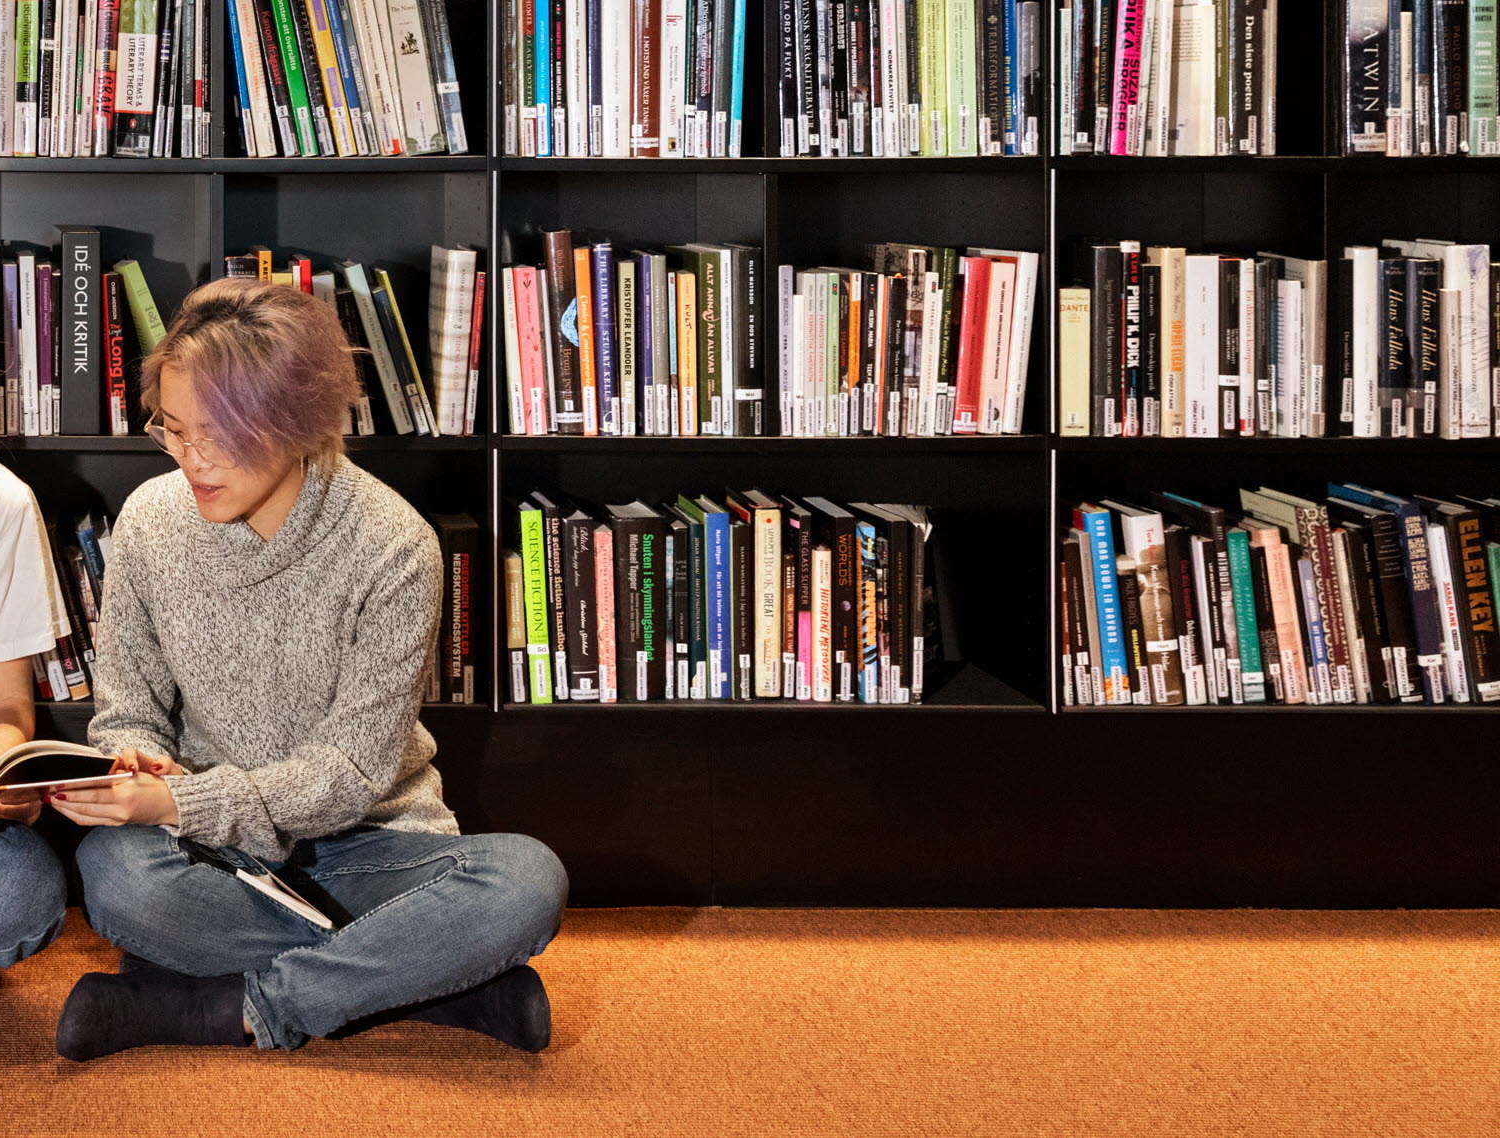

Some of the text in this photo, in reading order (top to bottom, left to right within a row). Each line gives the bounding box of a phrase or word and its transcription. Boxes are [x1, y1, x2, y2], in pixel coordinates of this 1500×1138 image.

[22, 3, 32, 78] BEGINNING THEORY
[137, 37, 145, 71] LITERARY
[262, 11, 281, 85] Kanon ifrågasatt
[282, 25, 296, 71] att översätta
[700, 9, 709, 37] Dictionary
[783, 15, 793, 78] ORD PÅ FLYKT
[126, 38, 135, 106] LITERARY THEORY
[136, 74, 144, 99] TERMS
[643, 41, 651, 78] MOTSTÅND
[803, 35, 815, 127] SKRÄCKLITTERATUR
[1115, 59, 1129, 131] BRØGGER
[1243, 16, 1254, 111] Den siste poeten
[74, 246, 90, 373] IDÉ OCH KRITIK
[600, 255, 612, 402] THE LIBRARY STUART KELLS
[624, 278, 632, 375] KRISTOFFER LEANDOER
[704, 287, 715, 321] ANNAT
[707, 323, 716, 334] ÄN
[1127, 286, 1139, 368] PHILIP K. DICK
[1389, 289, 1403, 370] Hans Fallada
[1422, 290, 1436, 371] Hans Fallada
[110, 337, 123, 377] Long
[707, 336, 715, 373] ALLVAR
[528, 521, 543, 632] SCIENCE FICTION
[552, 518, 563, 609] the science fiction
[629, 534, 639, 590] Michael Tapper
[642, 534, 653, 569] Snuten
[838, 534, 848, 586] WORLDS
[1095, 520, 1117, 643] OUR MAN DOWN IN HAVANA
[1458, 519, 1494, 632] ELLEN KEY
[453, 553, 461, 677] NEDSKRIVNINGSSYSTEM
[642, 578, 654, 661] skymningslandet
[764, 593, 773, 617] GREAT
[1444, 583, 1456, 627] SARAH KANE
